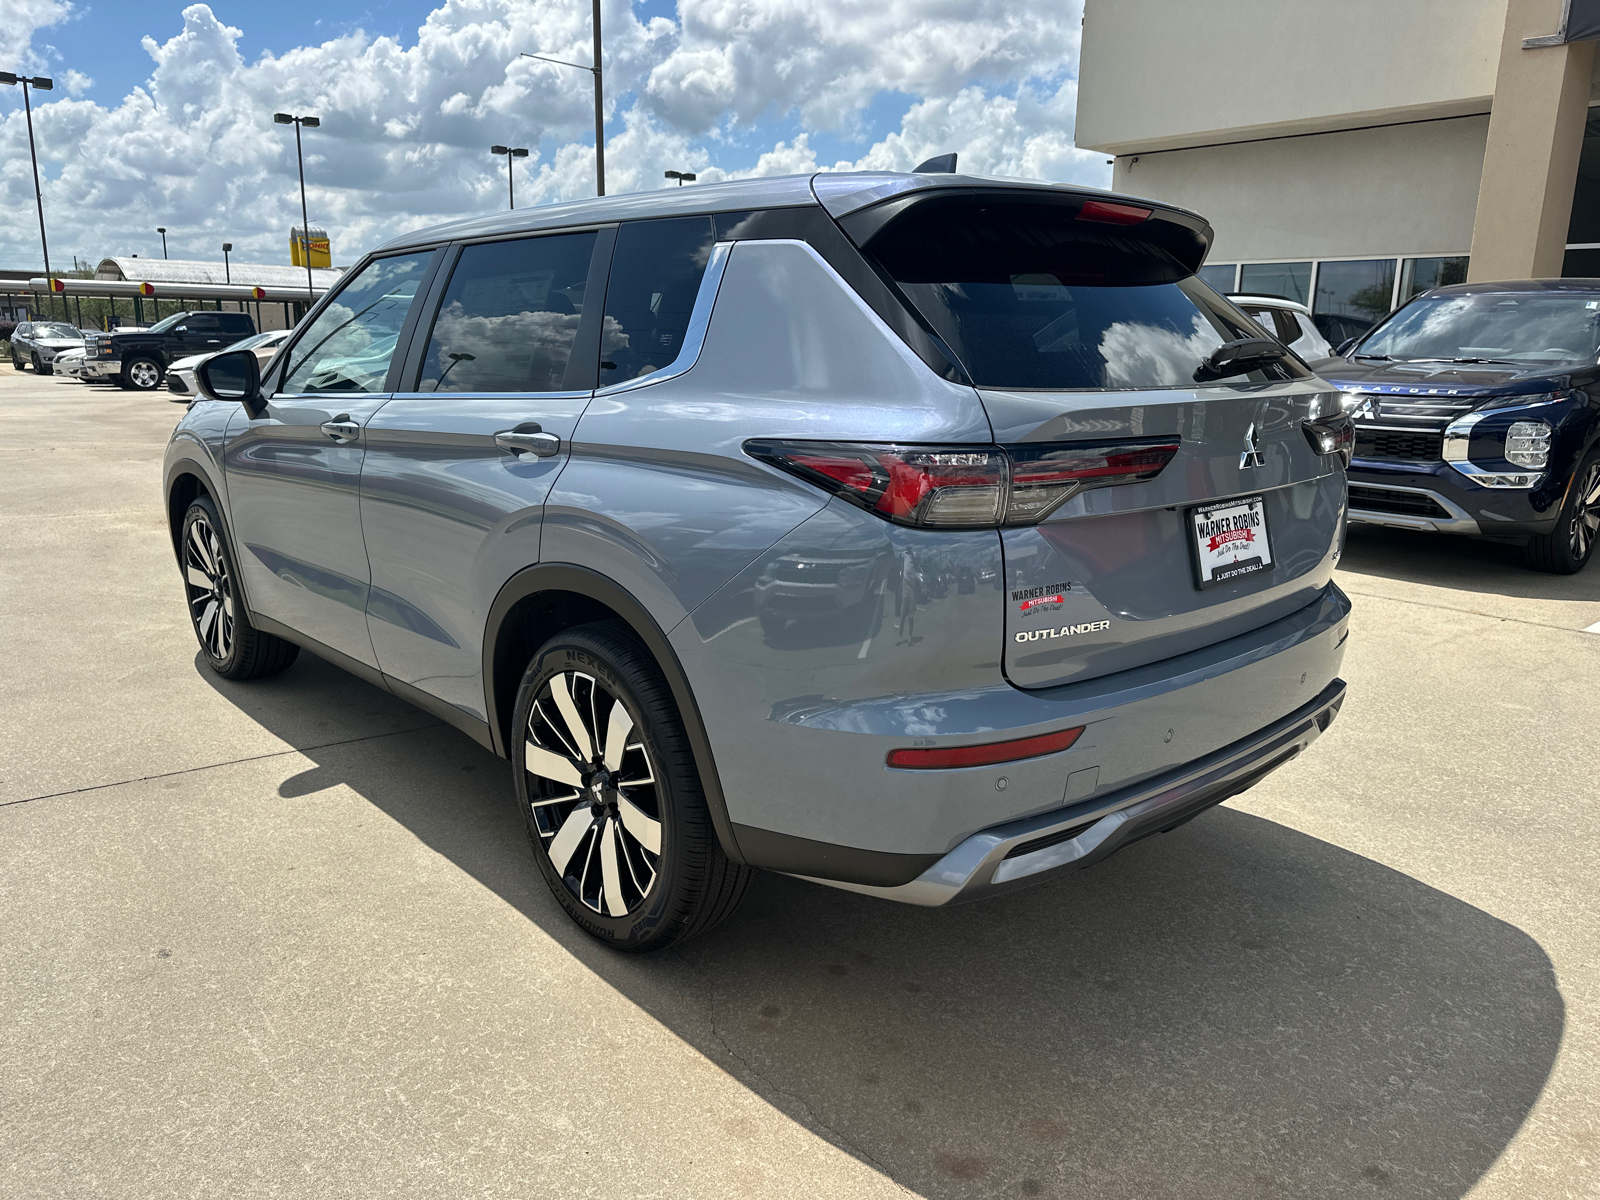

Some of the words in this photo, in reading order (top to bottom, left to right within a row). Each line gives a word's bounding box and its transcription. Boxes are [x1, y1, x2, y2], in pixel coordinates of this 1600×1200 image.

[304, 242, 327, 250] ONIC
[1197, 517, 1231, 539] WARNER
[1233, 511, 1260, 531] ROBINS
[1215, 530, 1248, 545] MITSUBISHI
[1216, 546, 1225, 558] Just
[1225, 544, 1231, 553] Do
[1220, 571, 1231, 580] JUST
[1012, 587, 1044, 601] WARNER
[1046, 581, 1072, 596] ROBINS
[1028, 595, 1058, 606] MITSUBISHI
[1021, 609, 1032, 618] Just
[1015, 620, 1110, 643] OUTLANDER
[566, 650, 618, 687] NEXEN
